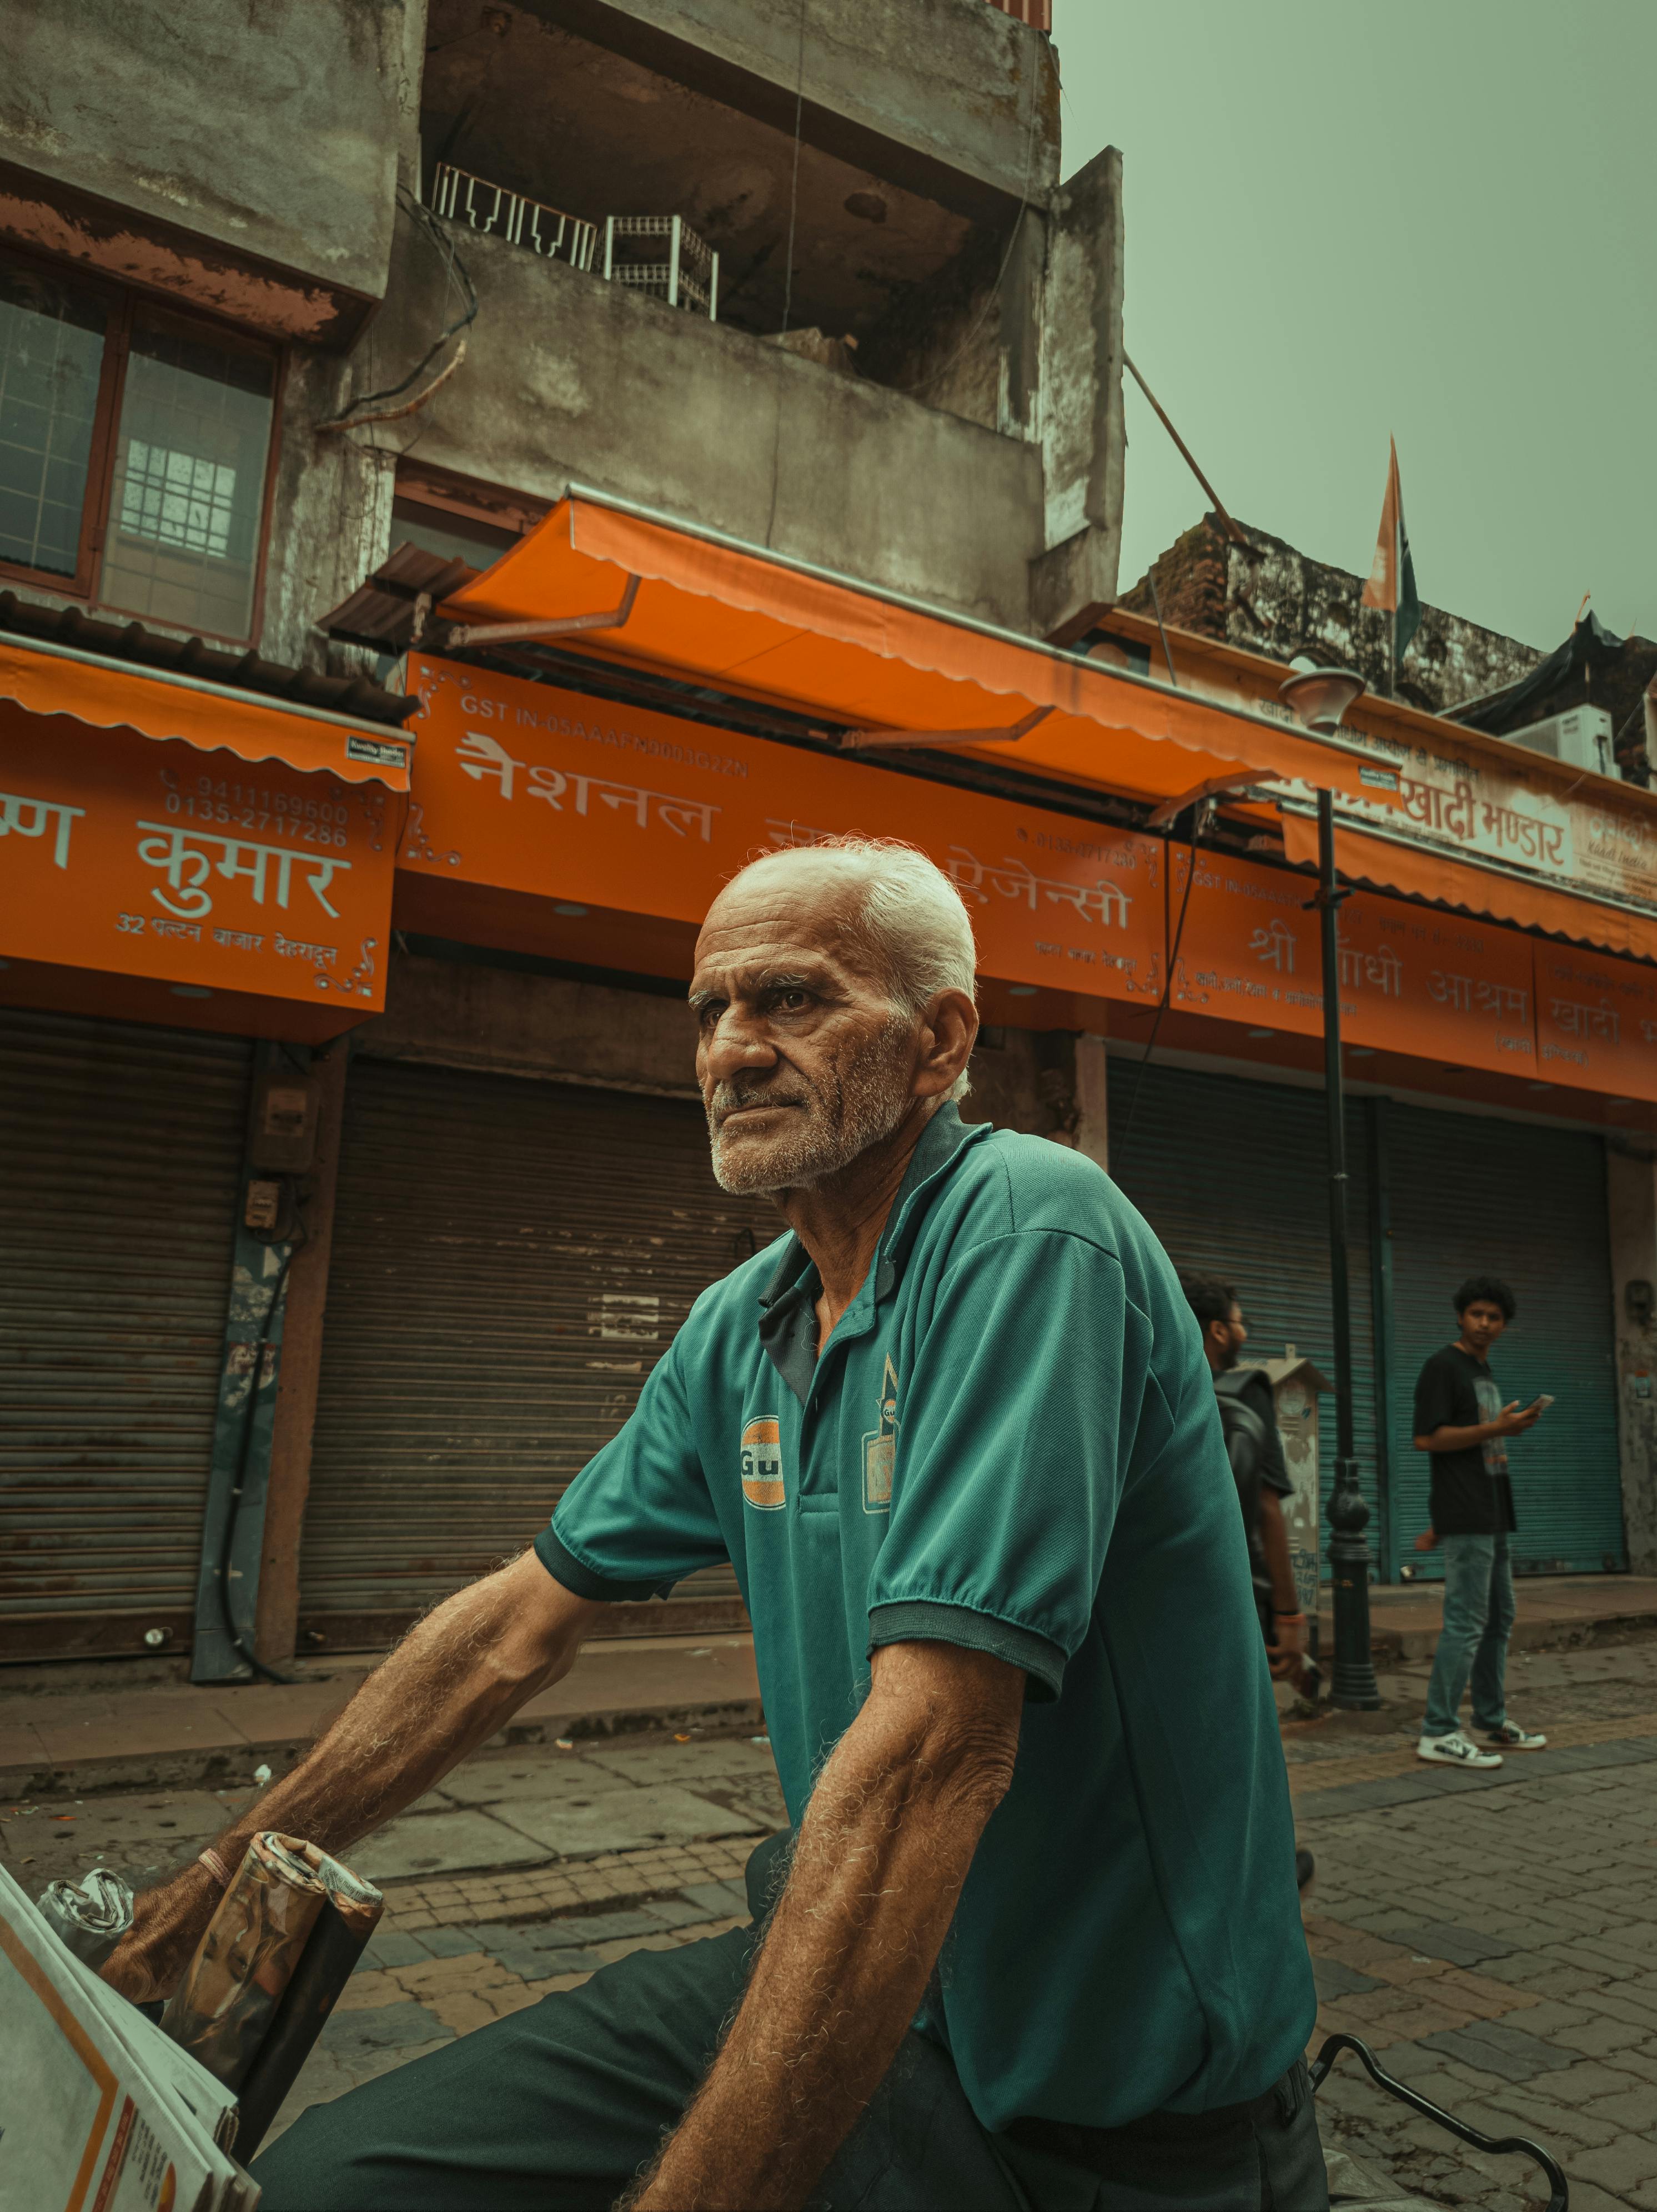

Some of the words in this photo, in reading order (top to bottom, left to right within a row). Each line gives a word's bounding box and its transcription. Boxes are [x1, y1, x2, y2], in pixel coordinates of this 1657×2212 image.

[460, 695, 508, 720] GST
[167, 792, 347, 847] 0135-2717286
[1400, 778, 1477, 843] खादी
[1482, 802, 1565, 867] भण्डार
[137, 820, 352, 918] कुमार
[1193, 871, 1222, 889] GST
[116, 912, 145, 934] 32
[150, 917, 204, 942] पल्टन
[213, 927, 265, 952] बाजार
[274, 931, 338, 969] देहरादून
[1248, 919, 1296, 974] श्री
[1425, 971, 1528, 1026] आश्रम
[1548, 996, 1620, 1044] खादी
